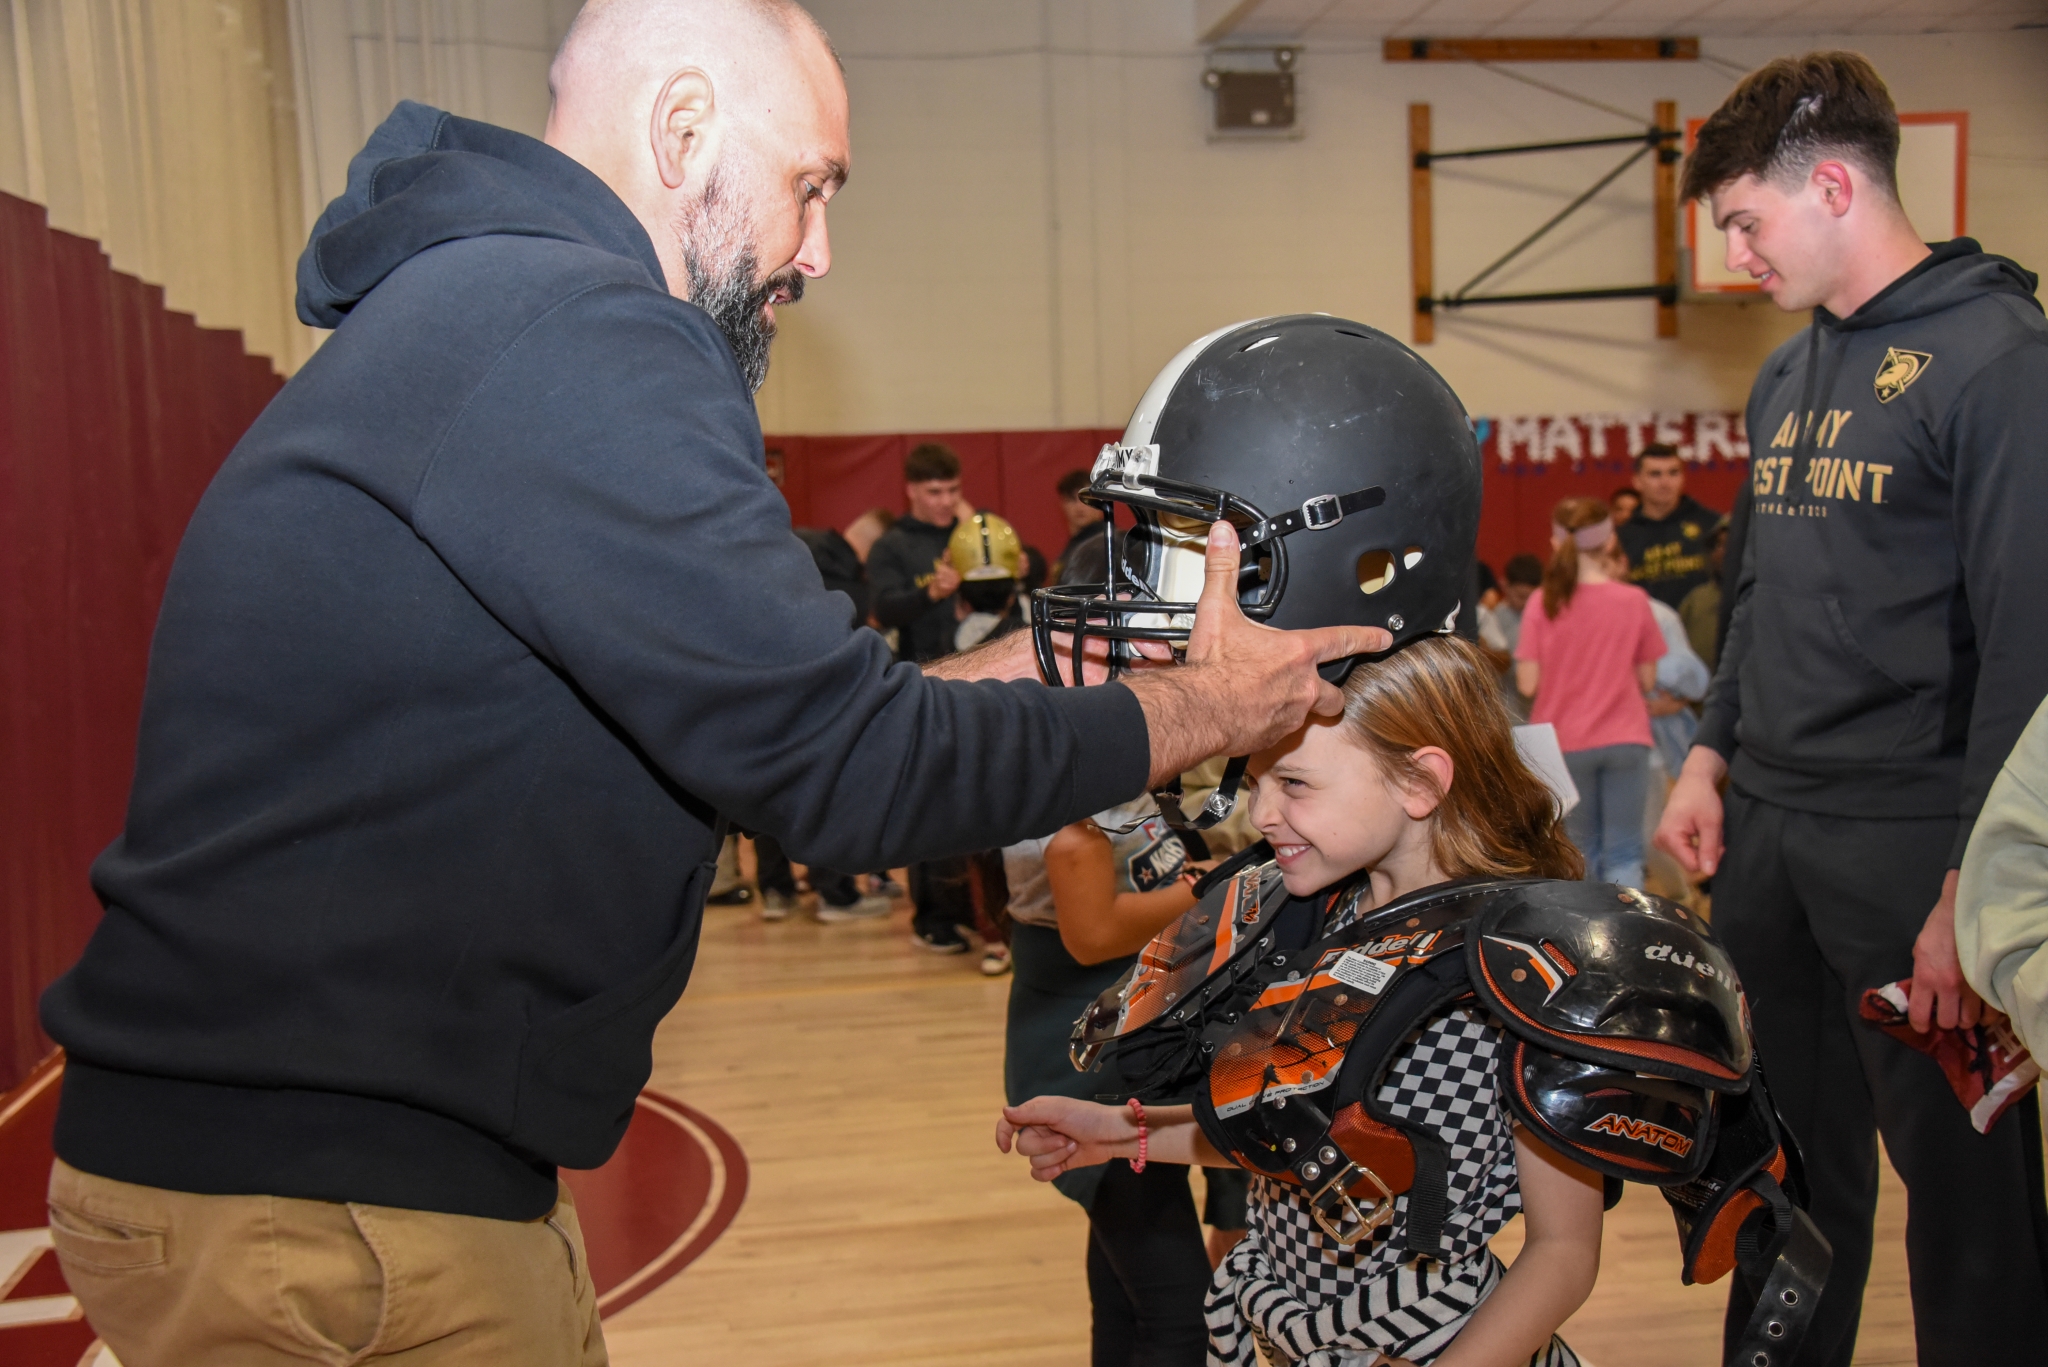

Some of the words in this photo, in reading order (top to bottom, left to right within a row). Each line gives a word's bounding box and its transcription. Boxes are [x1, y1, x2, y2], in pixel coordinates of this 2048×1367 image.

[1753, 456, 1793, 497] EST
[1312, 929, 1443, 971] ddell
[1584, 1113, 1693, 1158] ANATOM
